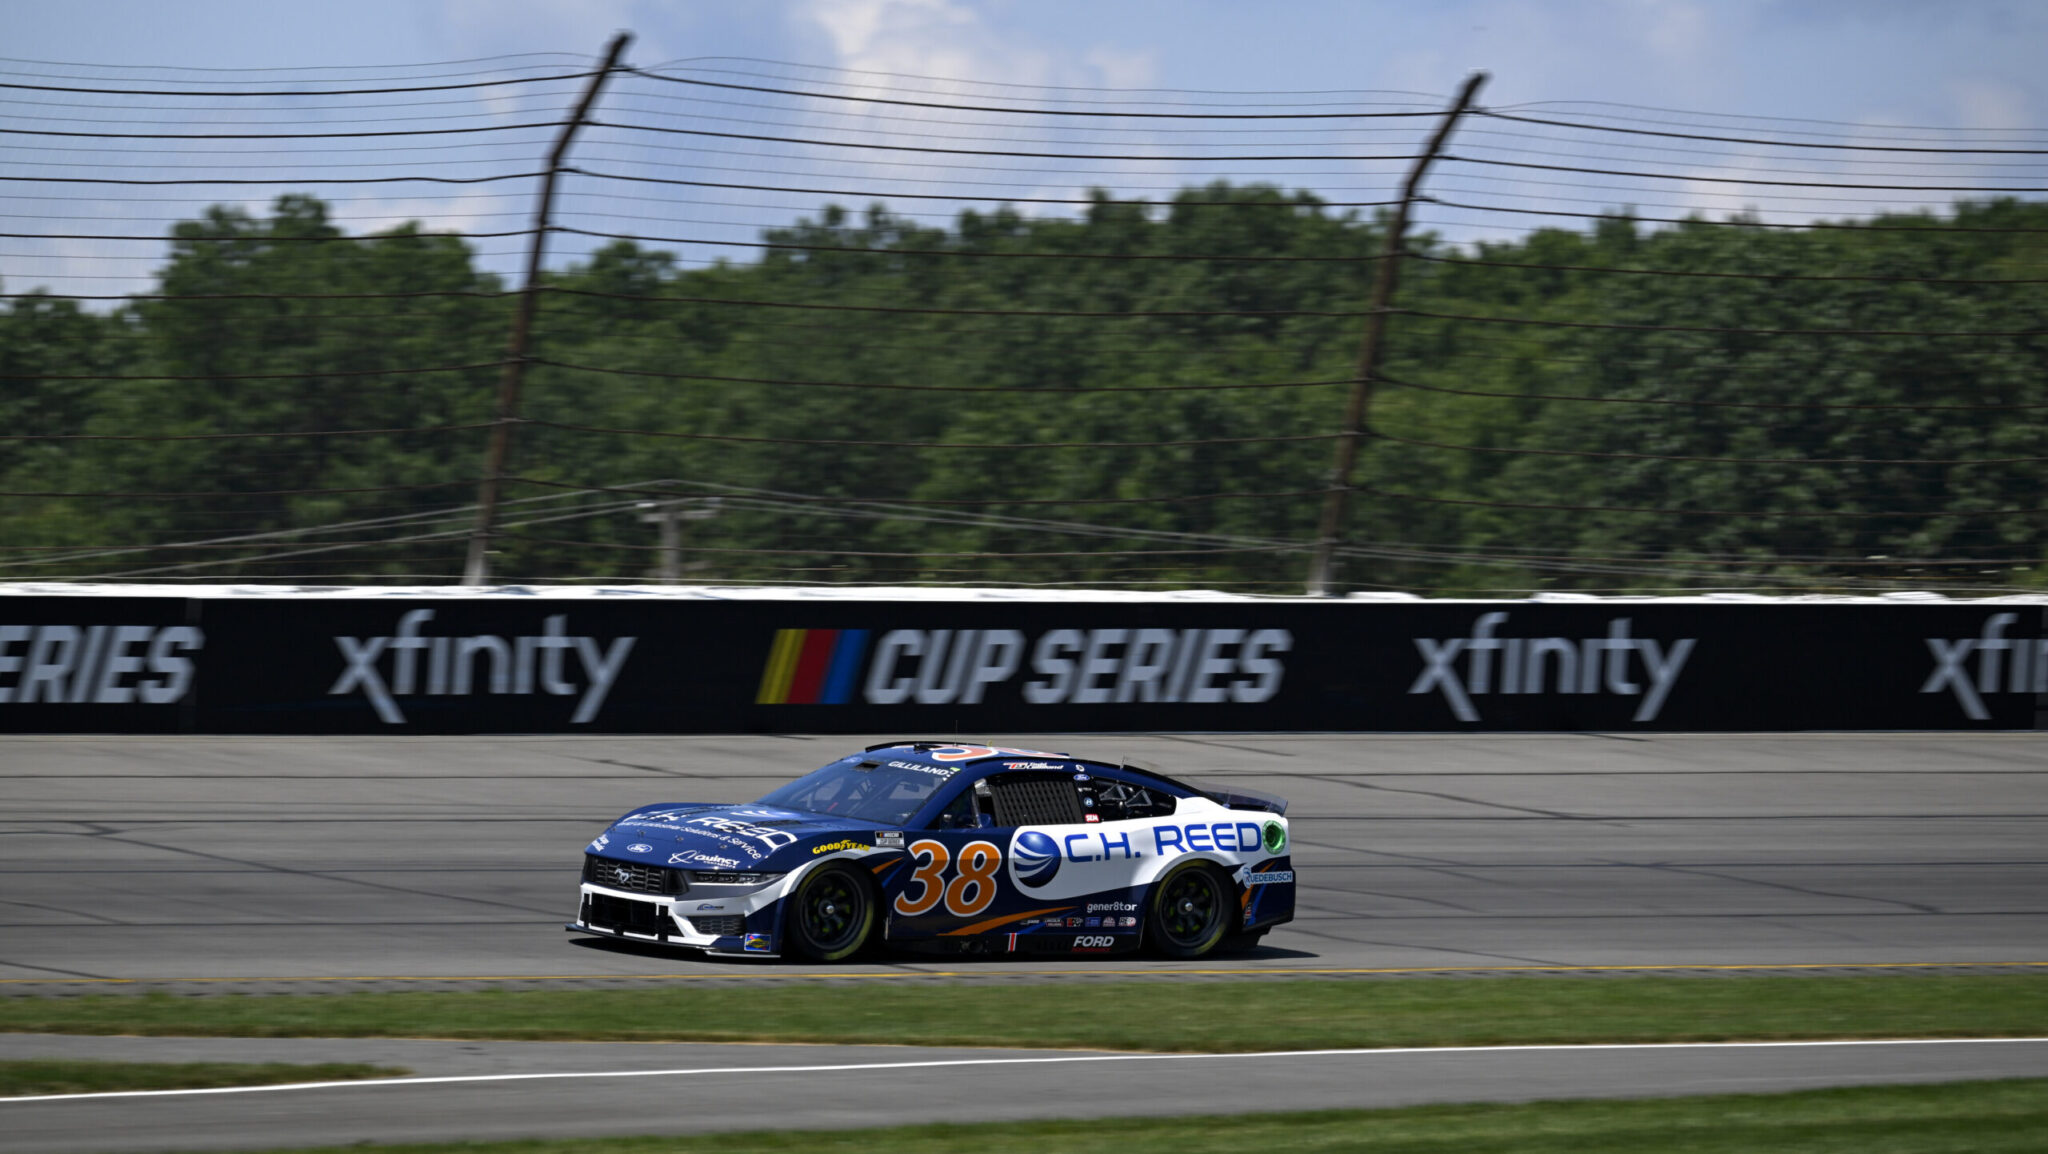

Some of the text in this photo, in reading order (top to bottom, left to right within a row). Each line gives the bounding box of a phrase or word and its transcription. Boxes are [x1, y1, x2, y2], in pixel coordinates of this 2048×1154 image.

[328, 608, 638, 724] xfinity
[864, 628, 1294, 704] CUP SERIES
[1407, 611, 1697, 722] xfinity
[1918, 612, 2048, 720] xfi
[888, 760, 949, 777] GILLILAND
[728, 837, 762, 860] Service
[812, 839, 871, 854] GOODYEAR
[1064, 822, 1262, 862] C.H. REED
[894, 839, 1002, 919] 38
[1087, 902, 1137, 913] gener8tor
[1073, 936, 1115, 947] FORD
